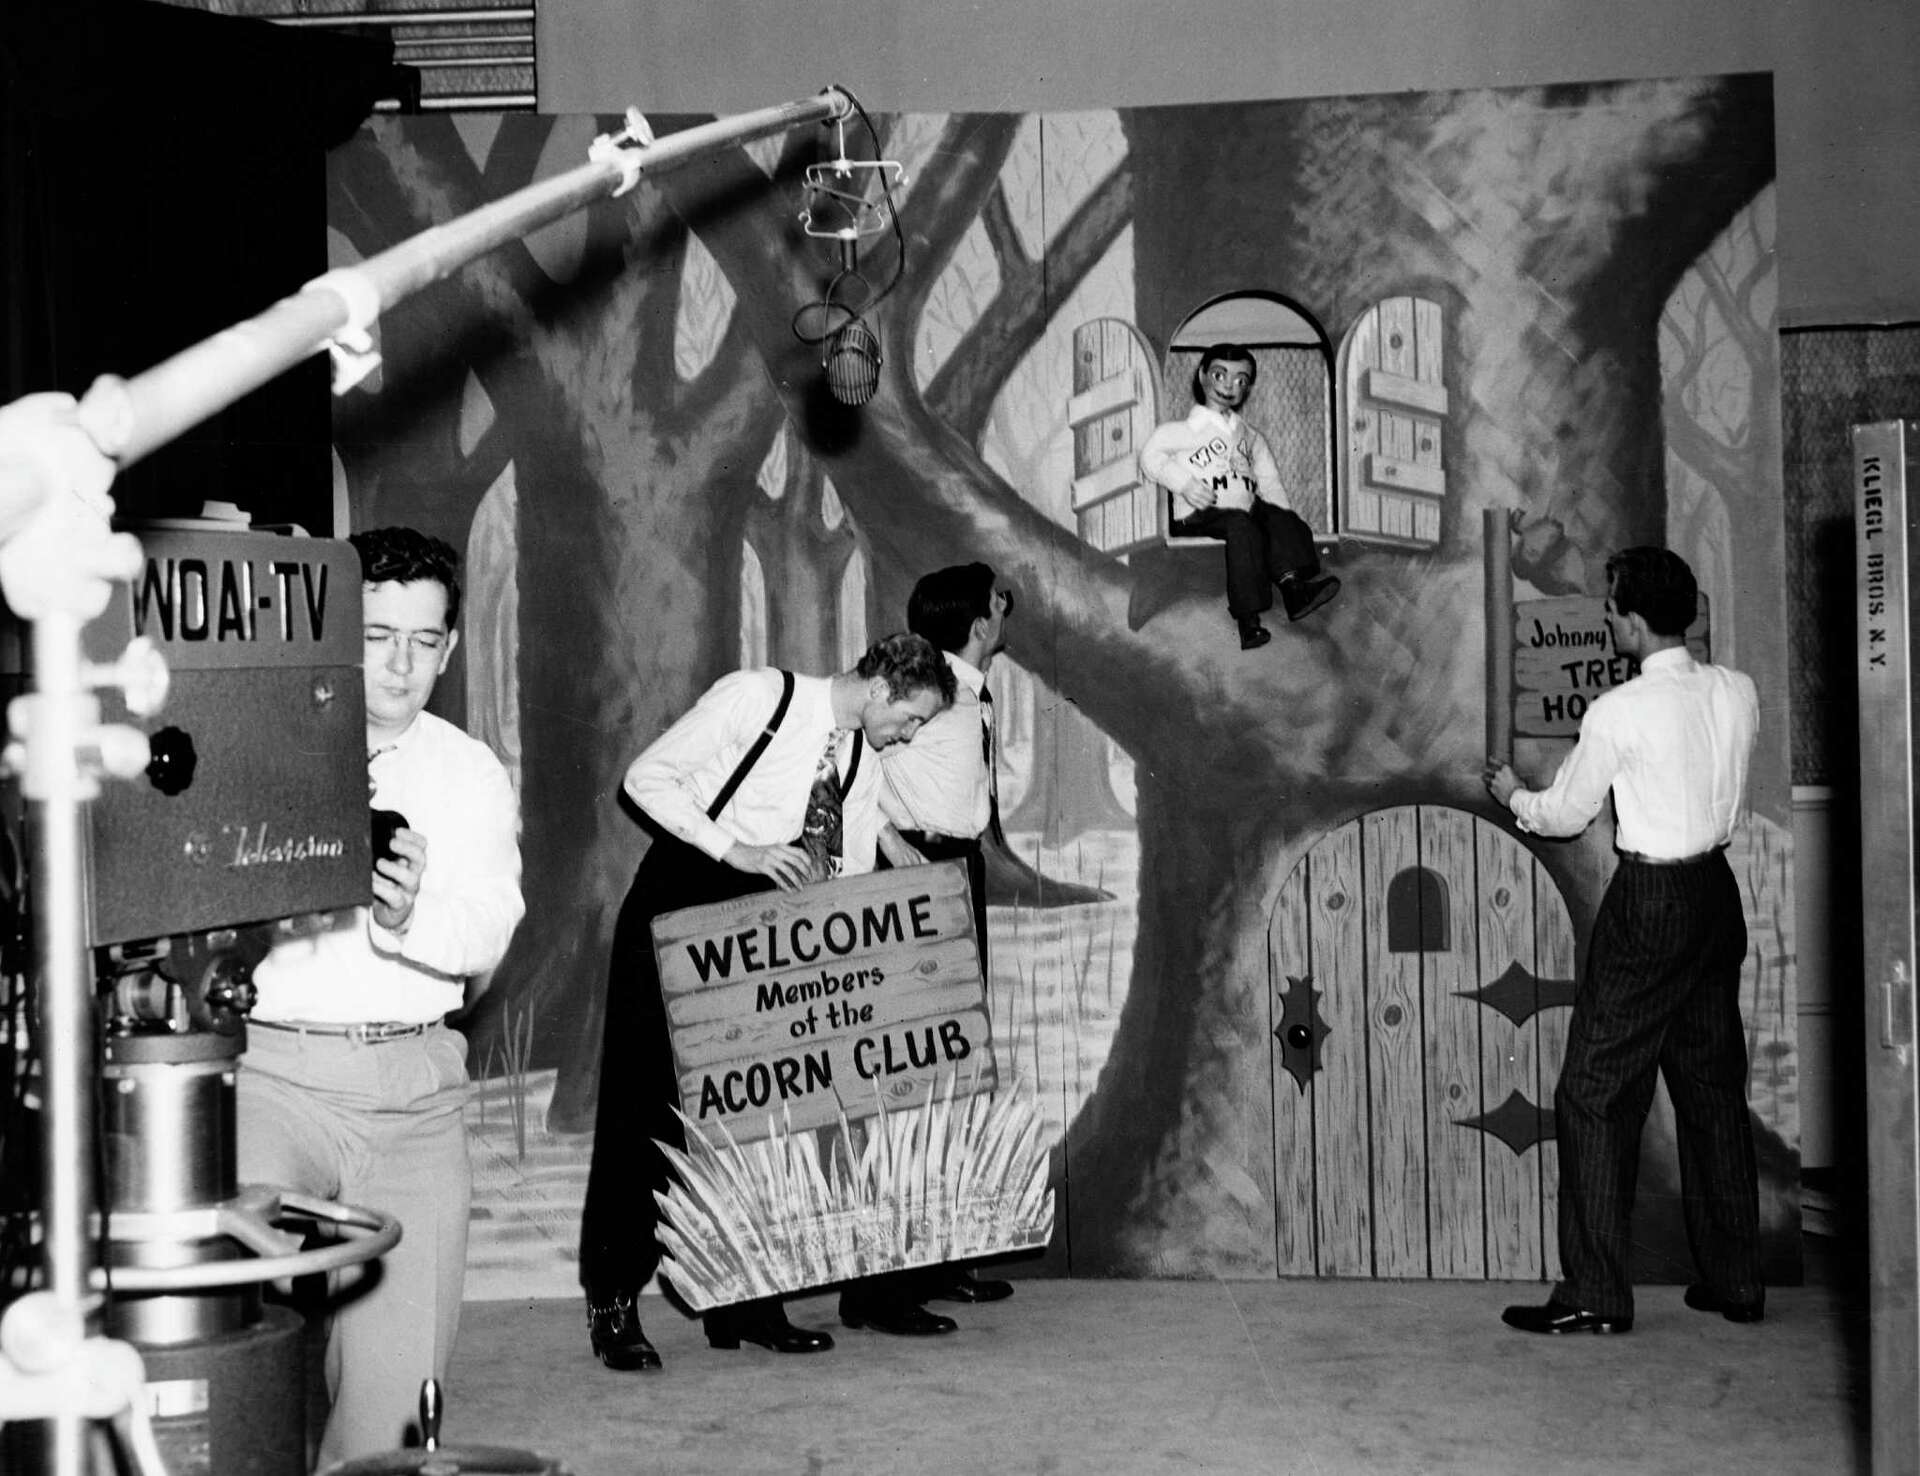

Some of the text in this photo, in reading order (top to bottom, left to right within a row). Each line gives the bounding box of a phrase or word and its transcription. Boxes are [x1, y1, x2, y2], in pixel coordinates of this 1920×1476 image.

[1863, 456, 1883, 540] KLIEGL
[132, 557, 329, 642] WOAI-TV
[1530, 617, 1607, 653] Johnny
[1542, 693, 1598, 723] HO
[686, 894, 939, 983] WELCOME
[756, 966, 885, 1013] Members
[789, 1000, 874, 1038] of the
[699, 1019, 971, 1119] ACORN CLUB
